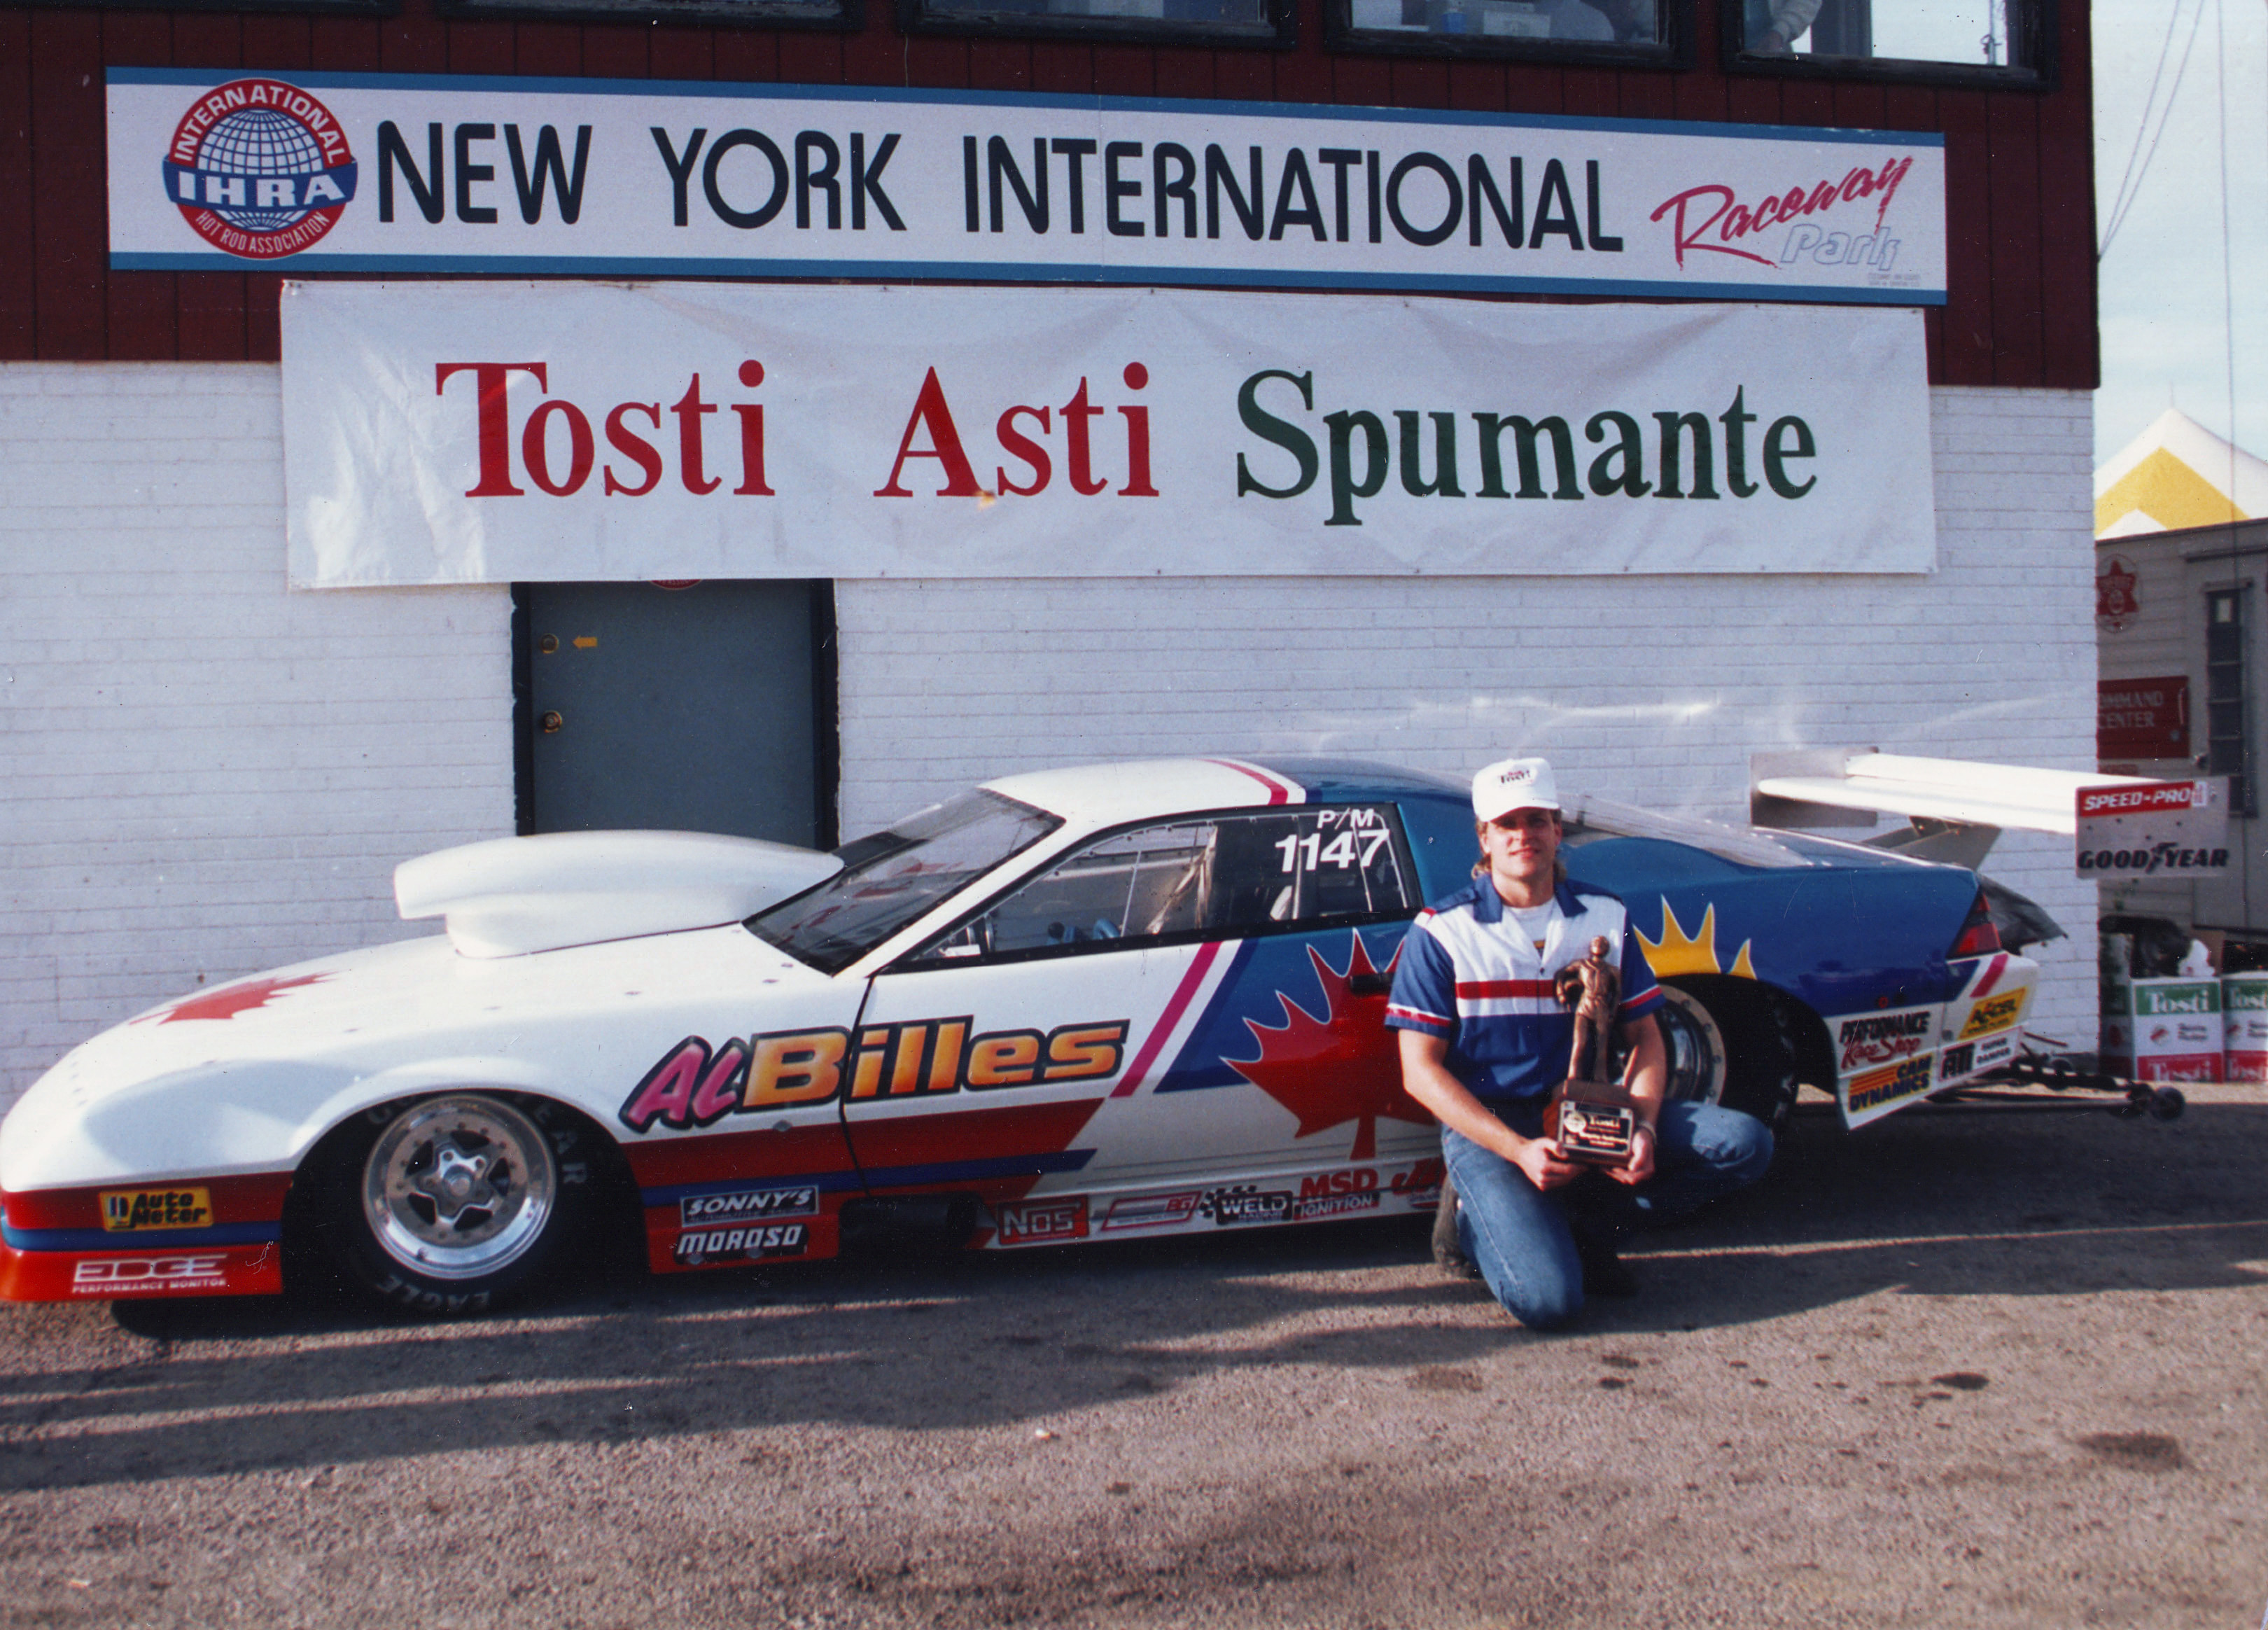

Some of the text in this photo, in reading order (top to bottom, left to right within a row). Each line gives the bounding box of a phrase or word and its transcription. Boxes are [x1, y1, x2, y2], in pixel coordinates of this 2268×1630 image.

[174, 84, 345, 164] INTERNATIONAL
[178, 171, 346, 207] IHRA
[378, 120, 1624, 253] NEW YORK INTERNATIONAL
[1650, 155, 1914, 271] Raceway
[195, 211, 330, 253] HOT ROD ASSOCIATION
[1779, 223, 1901, 271] Park
[435, 358, 1817, 527] Tosti Asti Spumante
[2083, 787, 2191, 811] SPEED-PRO
[1317, 807, 1374, 830] P/M
[1275, 829, 1390, 872] 1147
[2077, 842, 2230, 873] GOODYEAR
[734, 1014, 1130, 1113] Billes
[1897, 1054, 1933, 1079] CAM
[1849, 1072, 1930, 1112] DYNAMICS
[132, 1192, 195, 1211] Auto
[1299, 1168, 1378, 1203] MSD
[128, 1207, 208, 1230] Meter
[687, 1189, 813, 1216] SONNY'S
[1221, 1196, 1288, 1215] WELD
[1300, 1193, 1373, 1218] IGNITION
[1002, 1202, 1082, 1238] NOS
[676, 1225, 804, 1255] MOROSO
[74, 1253, 229, 1283] EDGE
[72, 1278, 227, 1294] PERFORMANCE MONITOR
